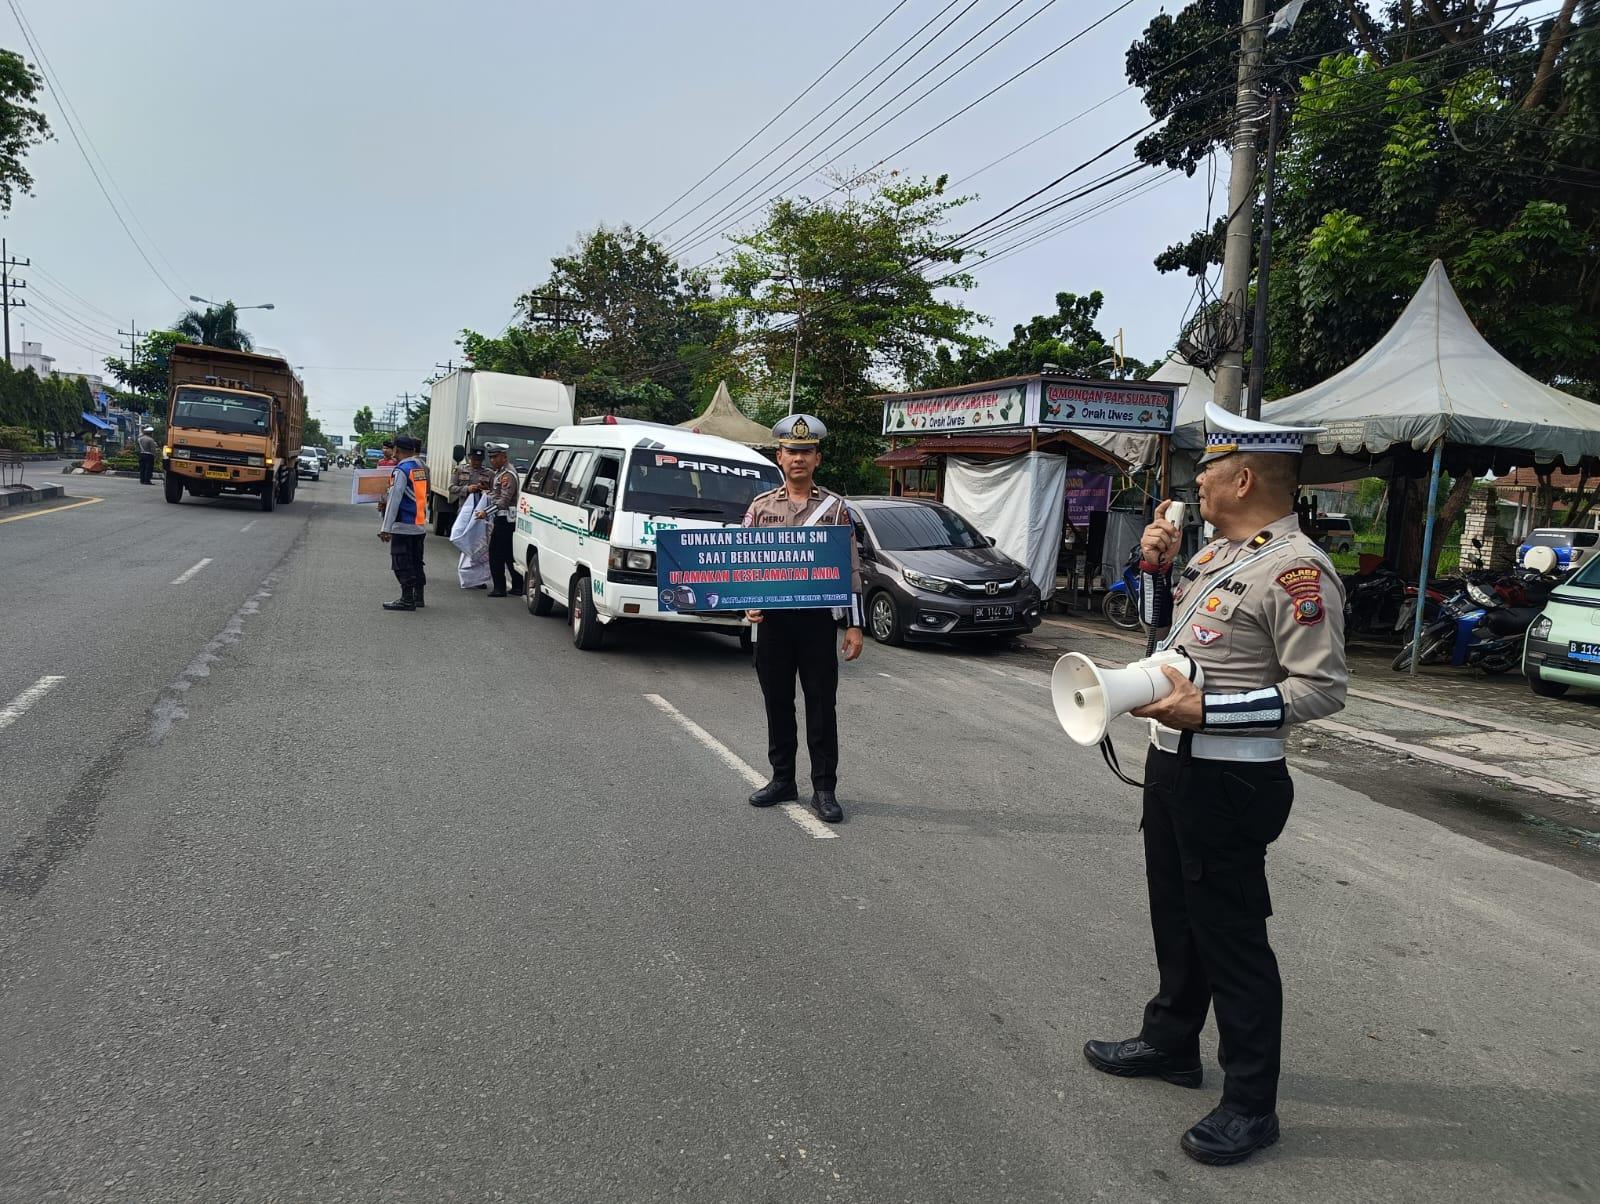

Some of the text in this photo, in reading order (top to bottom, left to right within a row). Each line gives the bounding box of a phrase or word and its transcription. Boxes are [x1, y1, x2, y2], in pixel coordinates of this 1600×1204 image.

[1048, 385, 1102, 404] LAMONGAN
[1104, 391, 1125, 403] PAK
[929, 416, 946, 428] Orah
[1082, 407, 1133, 421] Orah Uwes
[655, 454, 761, 479] PARNA
[762, 515, 785, 523] HERU
[680, 531, 828, 546] GUNAKAN SELALU HELM SNI
[698, 550, 815, 565] SAAT BERKENDARAAN
[669, 566, 840, 584] UTAMAKAN KESELAMATAN ANDA
[1279, 569, 1318, 586] POLRES
[593, 579, 604, 597] 684
[1215, 578, 1248, 596] OLRI
[1570, 642, 1577, 653] B
